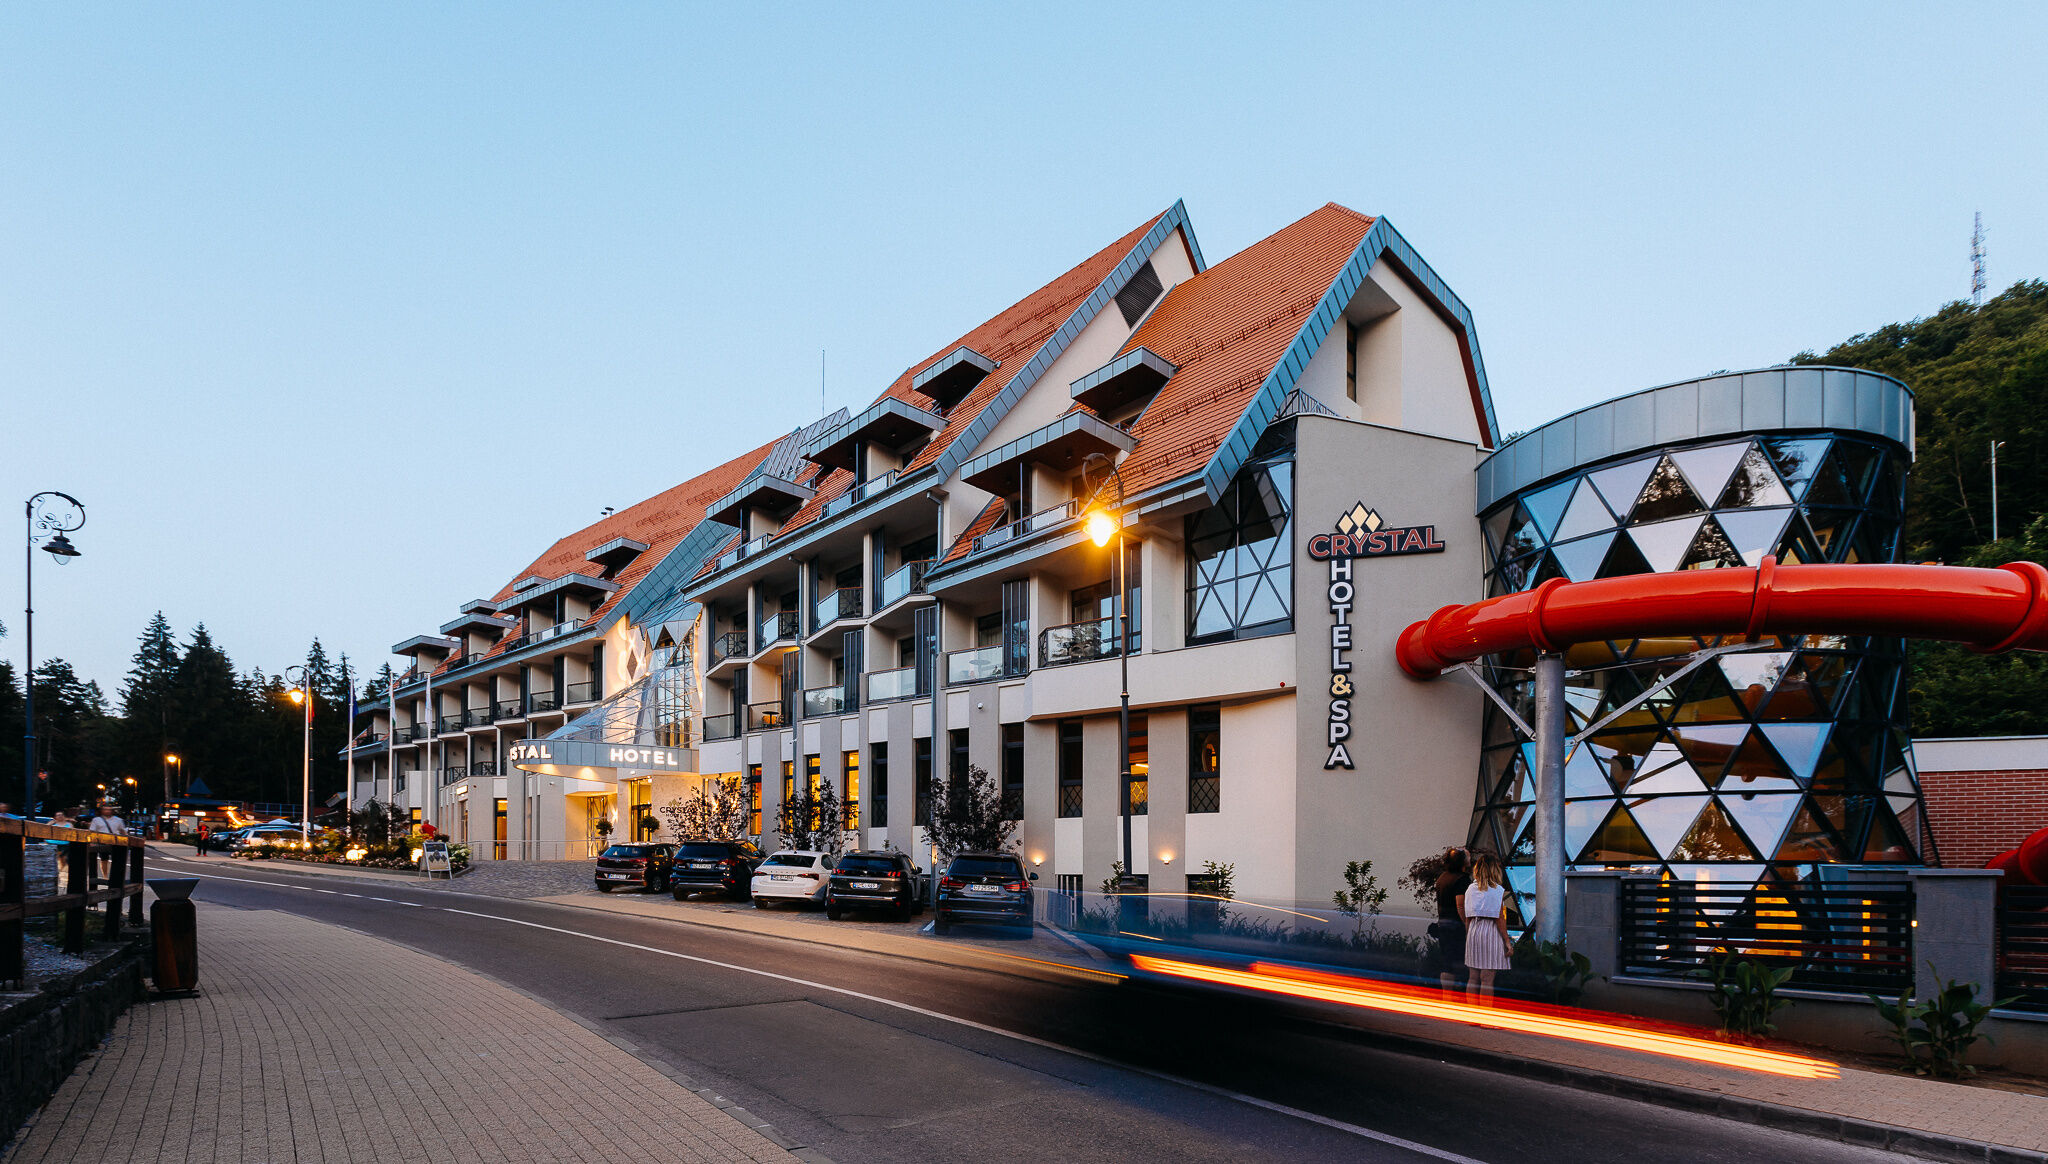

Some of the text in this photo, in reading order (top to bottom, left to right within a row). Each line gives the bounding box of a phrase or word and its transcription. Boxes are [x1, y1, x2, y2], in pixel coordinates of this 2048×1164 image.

[1310, 527, 1444, 557] CRYSTAL
[1328, 559, 1354, 766] HOTEL & SPA
[509, 744, 678, 766] STAL HOTEL
